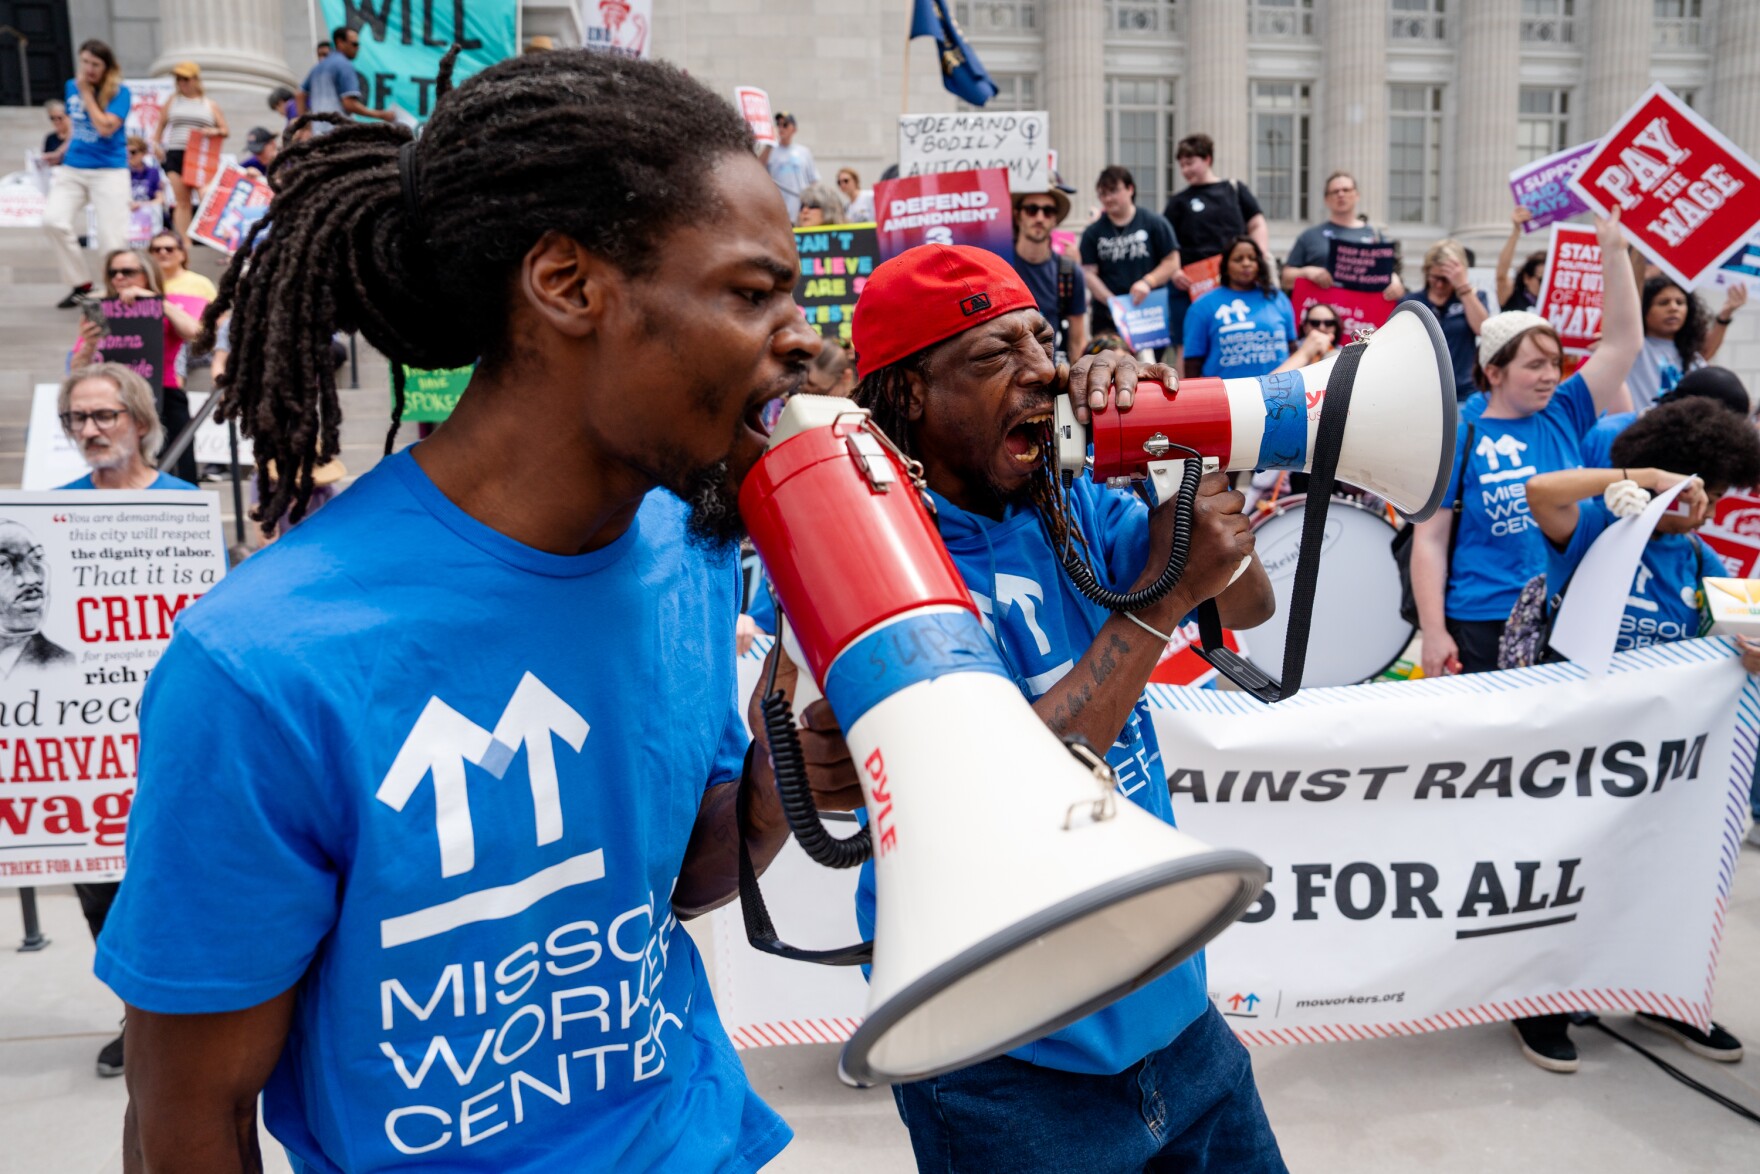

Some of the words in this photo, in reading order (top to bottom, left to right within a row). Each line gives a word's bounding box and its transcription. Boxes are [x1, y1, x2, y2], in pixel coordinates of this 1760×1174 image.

[344, 0, 482, 49] WILL
[921, 116, 1017, 134] DEMAND
[921, 134, 1008, 153] BODILY
[1523, 157, 1583, 193] SUPPO
[1595, 116, 1693, 211] PAY
[1652, 171, 1690, 203] THE
[890, 190, 989, 217] DEFEND
[1646, 163, 1745, 247] WAGE
[883, 207, 999, 233] AMENDMENT
[925, 226, 954, 246] 3
[1558, 242, 1602, 263] STAT
[800, 255, 873, 276] ELIEVE
[803, 277, 847, 298] ARE
[1554, 269, 1581, 290] GET
[1551, 288, 1575, 305] OF
[1482, 483, 1526, 507] MIS
[92, 514, 114, 523] are
[116, 511, 184, 526] demanding
[186, 511, 210, 523] that
[1485, 497, 1531, 521] WO
[69, 529, 97, 542] this
[100, 529, 129, 544] city
[131, 527, 158, 541] will
[161, 527, 211, 543] respect
[1491, 514, 1540, 537] CEN
[71, 547, 97, 560] the
[99, 546, 152, 562] dignity
[156, 546, 173, 558] of
[174, 546, 215, 559] labor.
[73, 564, 138, 588] That
[146, 564, 165, 585] it
[172, 563, 194, 585] is
[200, 568, 215, 585] a
[77, 593, 206, 643] CRIM
[82, 650, 103, 664] for
[104, 648, 144, 663] people
[147, 649, 161, 659] to
[84, 665, 138, 685] rich
[56, 696, 141, 726] rec
[1167, 764, 1410, 804] AINST
[1413, 732, 1709, 800] RACISM
[864, 747, 897, 858] PYLE
[0, 788, 134, 847] wag
[0, 860, 43, 877] TRIKE
[46, 859, 71, 875] FOR
[74, 858, 85, 873] A
[1291, 861, 1443, 921] FOR
[1456, 857, 1586, 918] ALL
[381, 896, 656, 1031] MISSO
[1295, 990, 1406, 1008] moworkers.org
